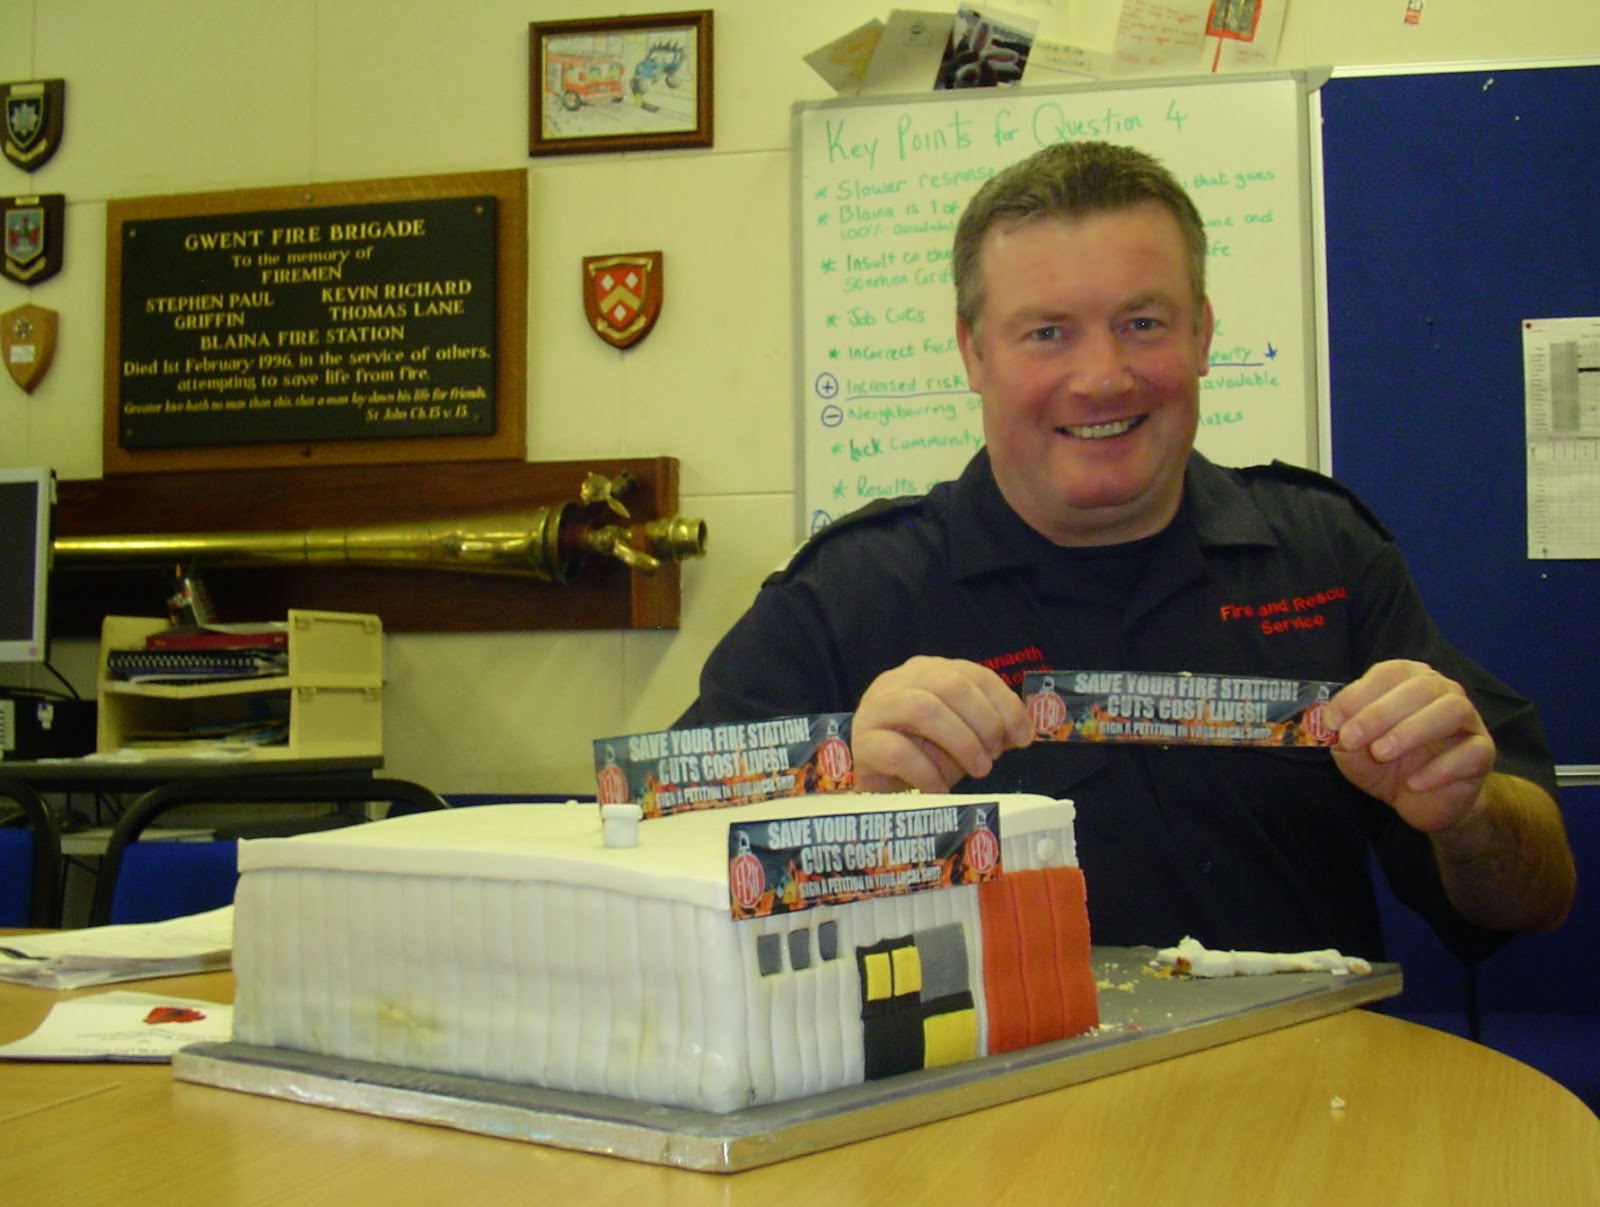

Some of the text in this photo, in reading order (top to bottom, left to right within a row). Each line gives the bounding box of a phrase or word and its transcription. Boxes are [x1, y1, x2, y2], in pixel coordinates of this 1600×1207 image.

[826, 99, 1188, 170] Key Points for Question 4
[836, 179, 908, 201] Slower
[906, 202, 919, 215] is
[184, 218, 426, 251] GWENT FIRE BRIGADE
[231, 245, 374, 269] To the memory of
[847, 252, 896, 272] Insult
[261, 265, 342, 285] FIREMEN
[145, 291, 274, 313] STEPHEN PAUL
[321, 279, 472, 304] KEVIN RICHARD
[174, 311, 245, 331] GRIFFIN
[329, 299, 464, 321] THOMAS LANE
[848, 307, 876, 327] Job
[200, 324, 405, 350] BLAINA FIRE STATION
[123, 359, 158, 377] Died
[185, 356, 254, 375] February
[298, 351, 313, 367] in
[319, 350, 343, 366] the
[349, 349, 404, 365] service
[410, 345, 430, 362] of
[177, 374, 256, 392] attempting
[261, 374, 278, 388] to
[282, 373, 318, 388] save
[325, 368, 349, 385] life
[355, 367, 395, 384] from
[926, 374, 966, 390] risk
[856, 475, 918, 496] Results
[1219, 604, 1253, 621] Fire
[1258, 600, 1289, 617] and
[1261, 615, 1325, 635] Service
[1074, 672, 1122, 695] SAVE
[1127, 673, 1175, 696] YOUR
[1178, 675, 1218, 698] FIRE
[1220, 678, 1299, 701] STATION!
[1107, 694, 1151, 717] CUTS
[1158, 697, 1204, 720] COST
[628, 717, 811, 762] SAVE YOUR FIRE STATION!
[658, 756, 699, 786] CUTS
[702, 752, 743, 782] COST
[767, 806, 959, 850] SAVE YOUR FIRE STATION!
[801, 845, 844, 874] CUTS
[844, 841, 887, 871] COST
